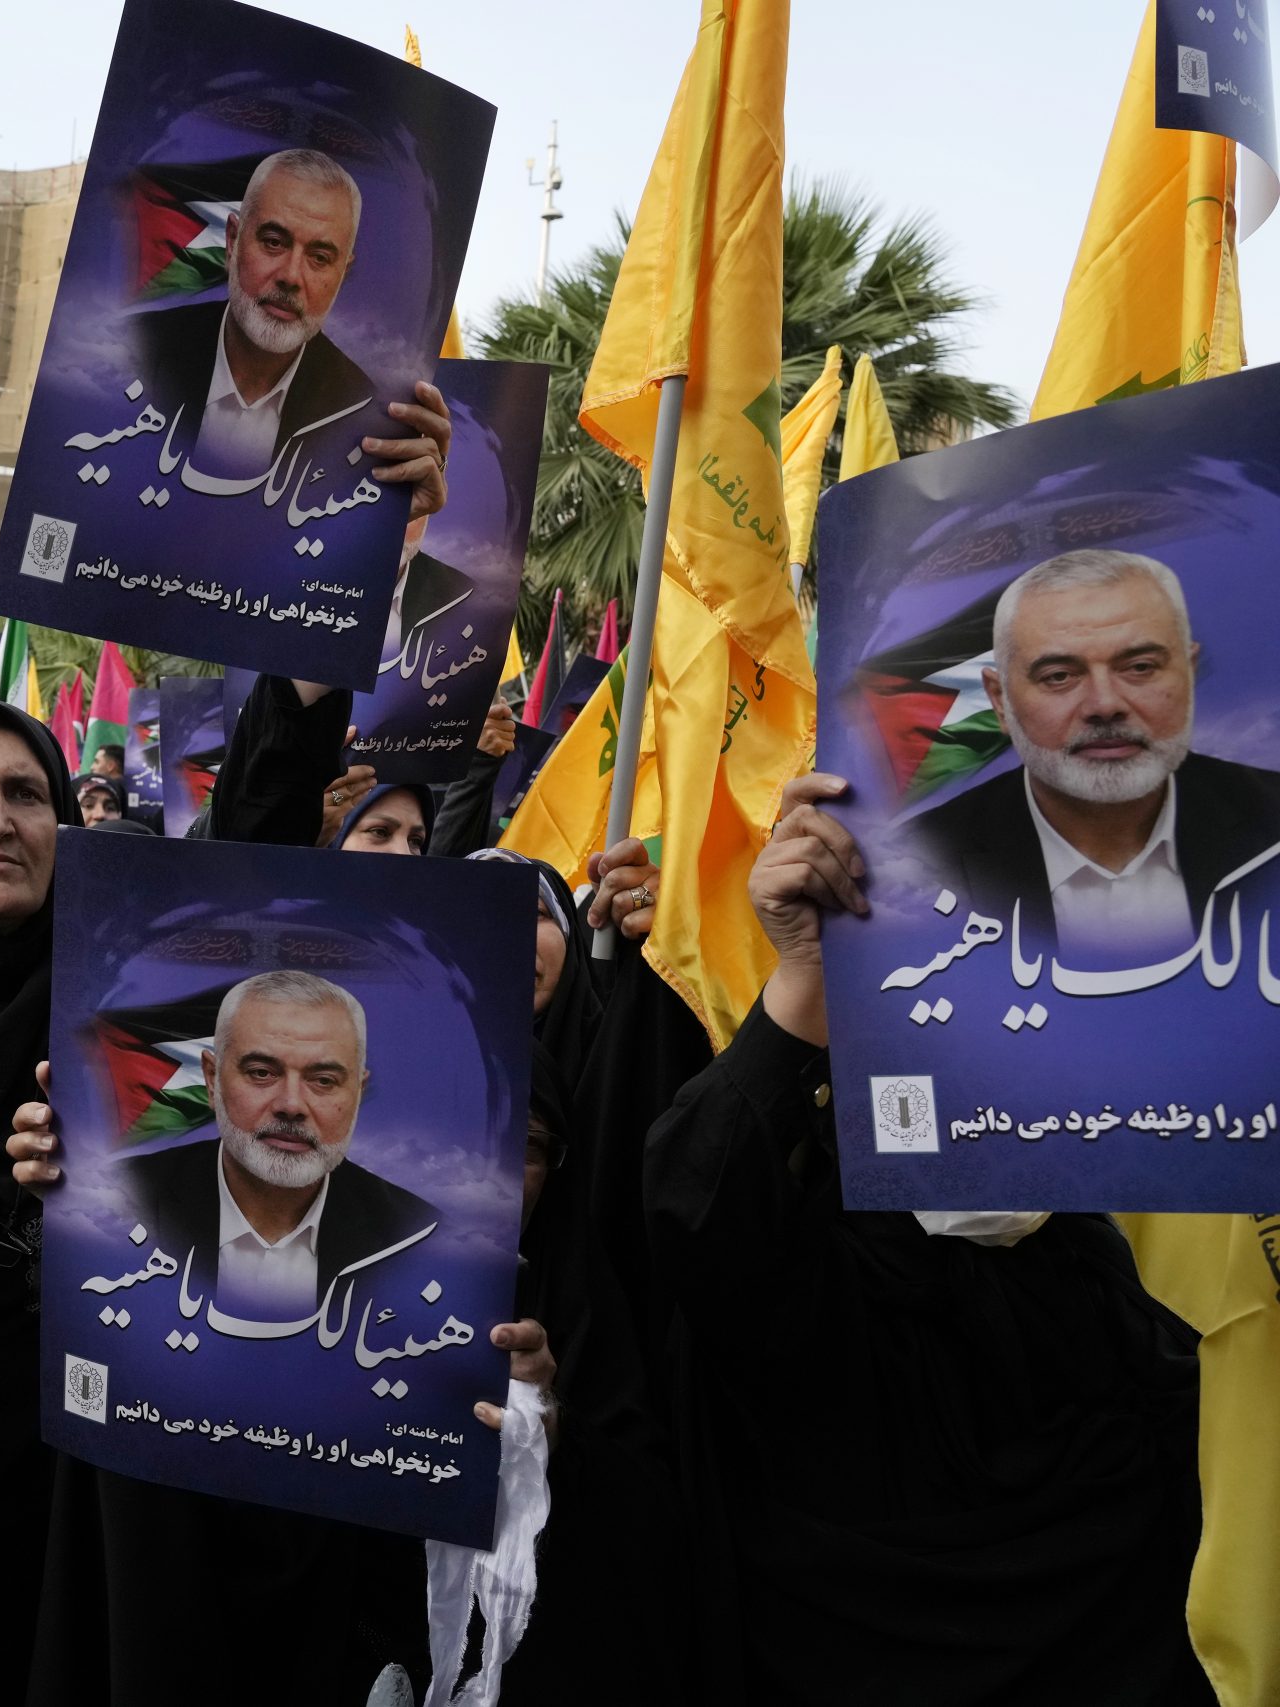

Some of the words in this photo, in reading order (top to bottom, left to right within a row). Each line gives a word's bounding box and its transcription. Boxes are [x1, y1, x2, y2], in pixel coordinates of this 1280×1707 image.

[150, 573, 184, 597] خود
[185, 580, 232, 611] وظیفه
[319, 583, 345, 597] خامنه
[345, 587, 364, 598] امام
[234, 588, 250, 614] را
[250, 593, 270, 617] او
[269, 601, 359, 633] خونخواهی
[1065, 1104, 1122, 1140] خود
[1127, 1103, 1212, 1139] وظیفه
[1213, 1103, 1245, 1139] را
[1248, 1102, 1278, 1139] او
[198, 1417, 240, 1442] خود
[243, 1423, 302, 1456] وظیفه
[408, 1427, 440, 1441] خامنه
[440, 1433, 464, 1447] امام
[306, 1432, 324, 1460] را
[327, 1438, 348, 1462] او
[350, 1447, 462, 1484] خونخواهی
